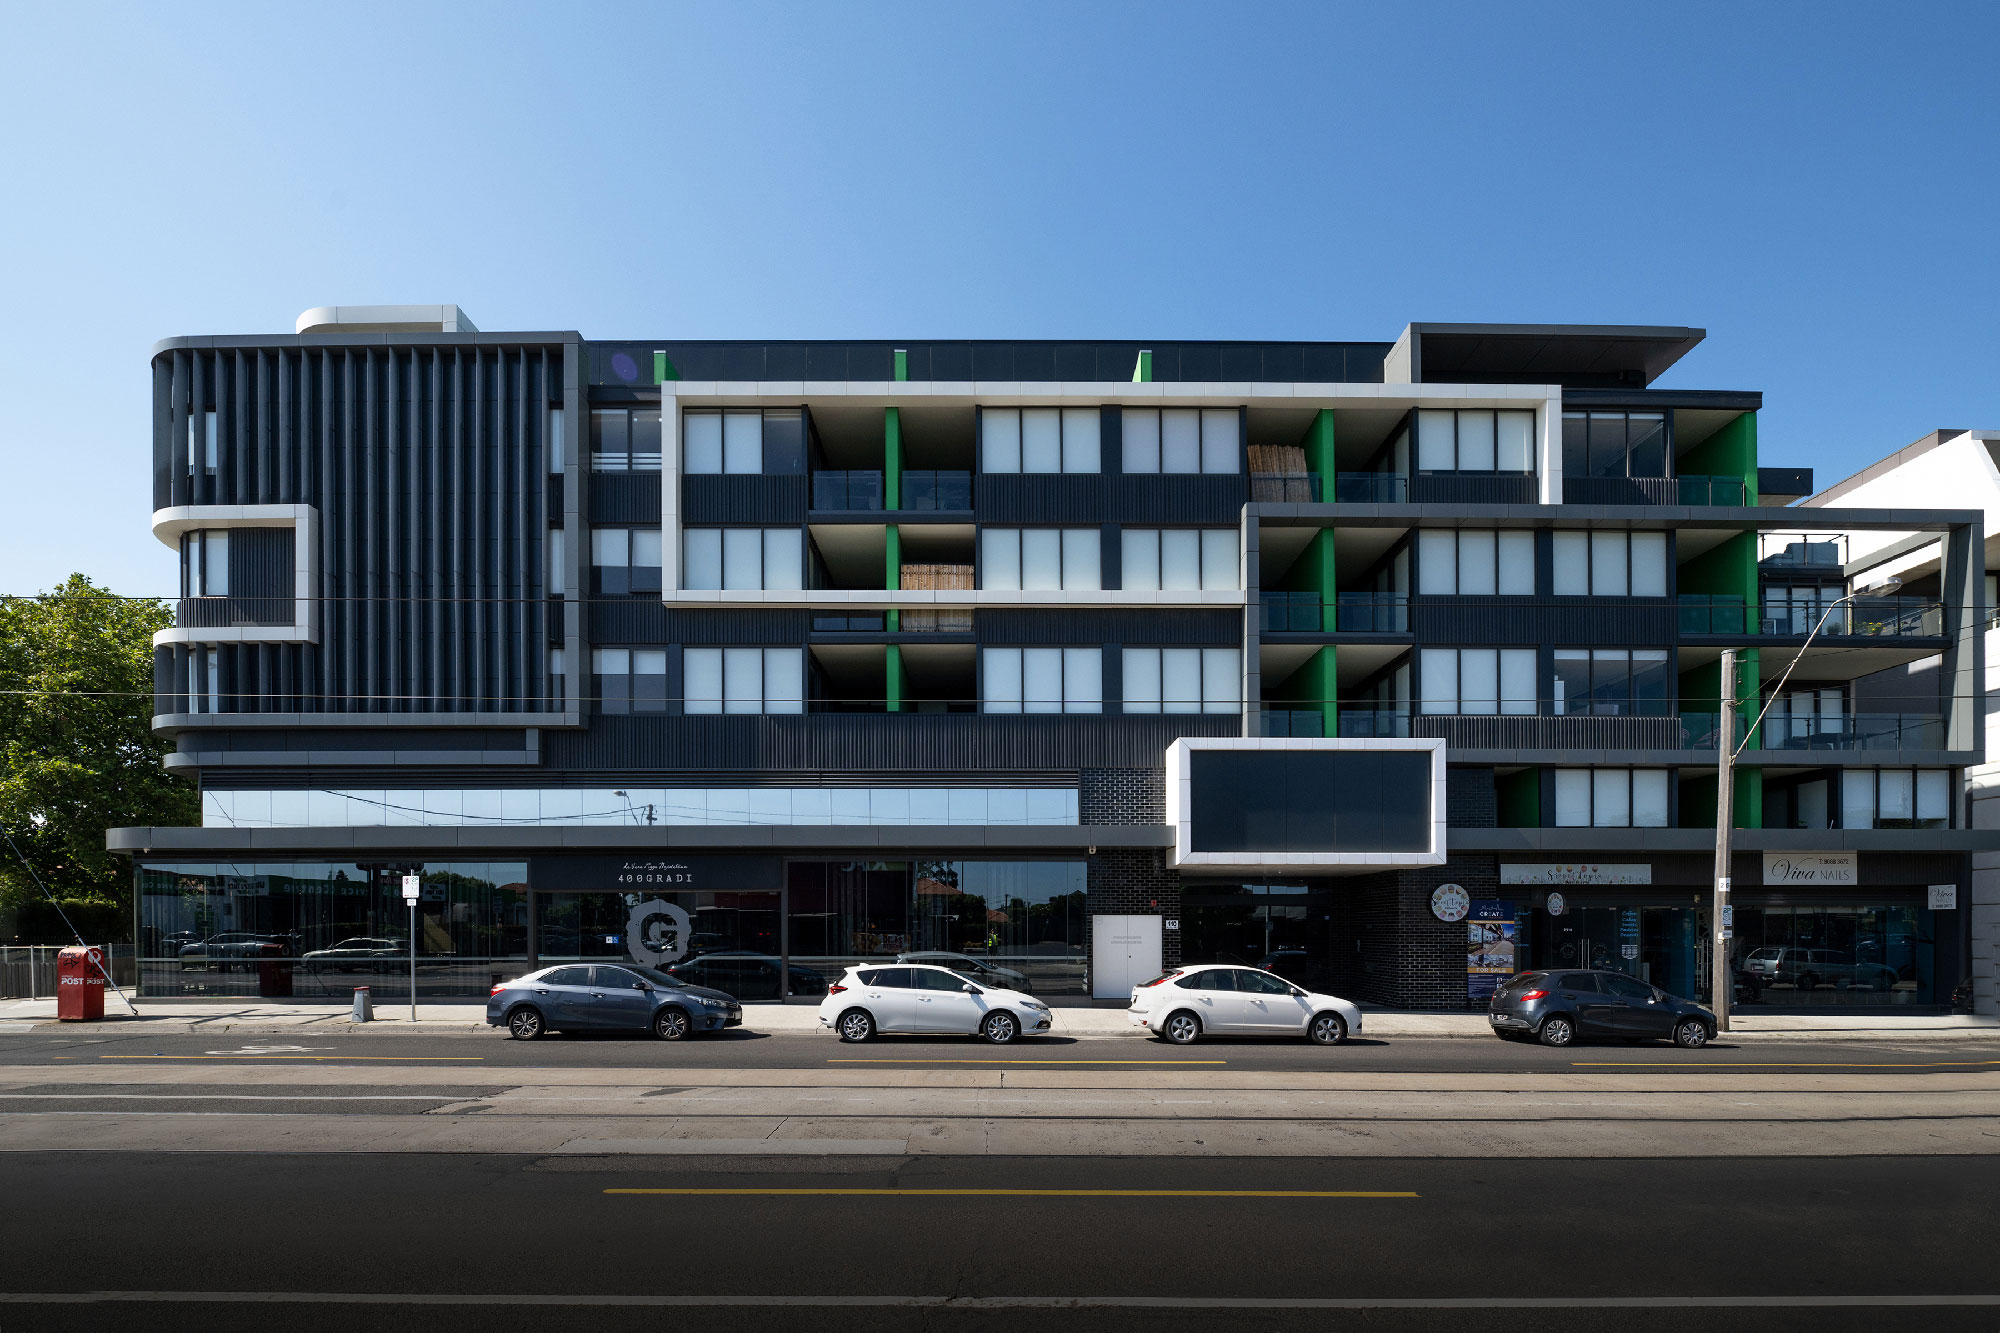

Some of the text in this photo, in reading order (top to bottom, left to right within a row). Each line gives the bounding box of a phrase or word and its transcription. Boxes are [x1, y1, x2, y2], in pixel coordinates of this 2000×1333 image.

[1772, 858, 1850, 882] Viva NAILS
[618, 874, 693, 883] 400GRADI
[61, 977, 85, 985] POST
